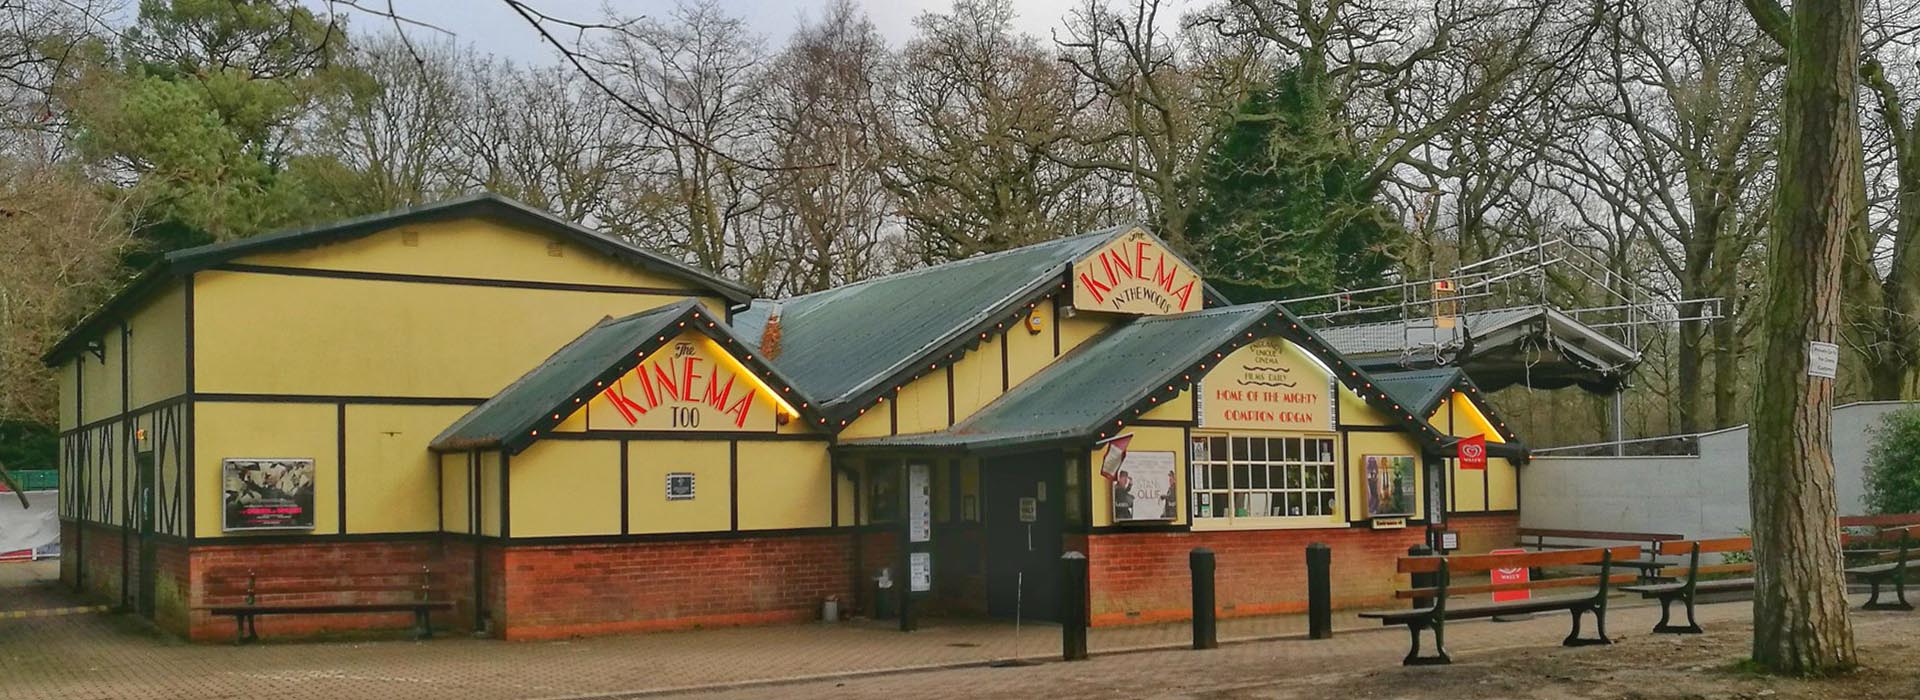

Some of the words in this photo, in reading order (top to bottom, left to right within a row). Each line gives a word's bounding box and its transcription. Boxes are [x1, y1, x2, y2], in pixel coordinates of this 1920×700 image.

[1080, 240, 1195, 311] KINEMA
[1112, 293, 1125, 310] IN
[1123, 286, 1142, 302] THE
[1143, 287, 1172, 313] WOODS
[675, 342, 697, 359] The
[604, 357, 757, 429] KINEMA
[1216, 389, 1243, 401] HOME
[1246, 390, 1258, 402] OF
[1263, 391, 1279, 403] THE
[1283, 393, 1318, 404] MIGHTY
[671, 406, 700, 428] TOO
[1279, 411, 1313, 423] ORGAN
